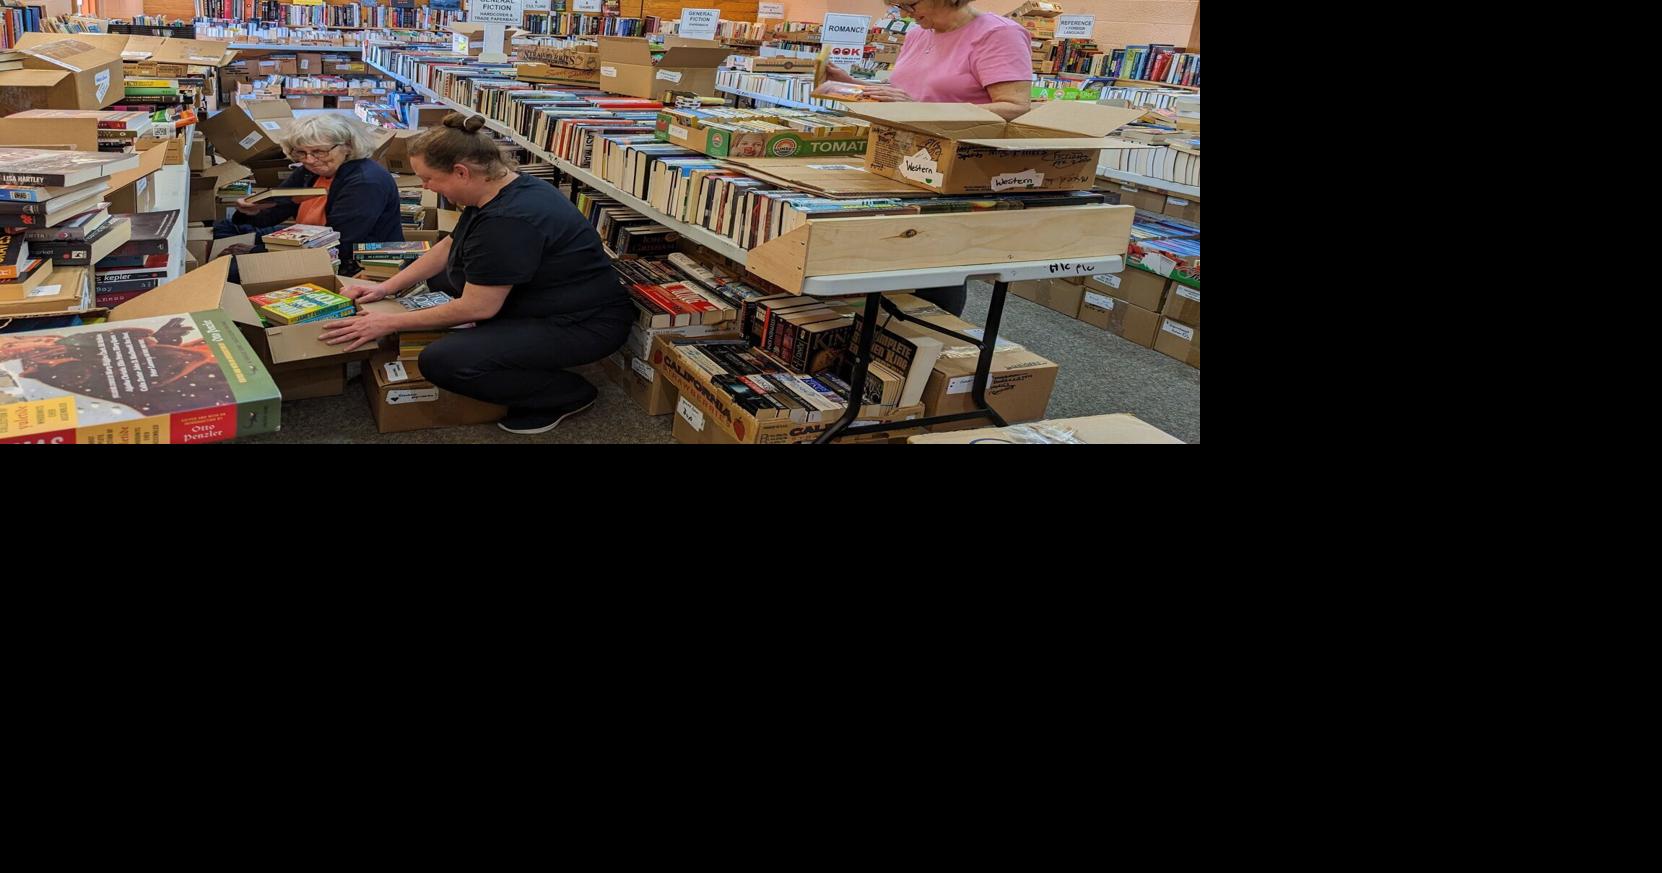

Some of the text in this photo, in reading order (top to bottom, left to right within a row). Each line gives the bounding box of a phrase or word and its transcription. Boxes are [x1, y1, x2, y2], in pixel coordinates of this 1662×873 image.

[828, 25, 865, 33] ROMANCE
[810, 140, 868, 154] TOMAT
[905, 160, 933, 174] Western
[17, 175, 45, 183] HARTLEY
[995, 177, 1033, 186] Western
[104, 273, 131, 282] kepler
[191, 424, 216, 433] Otto
